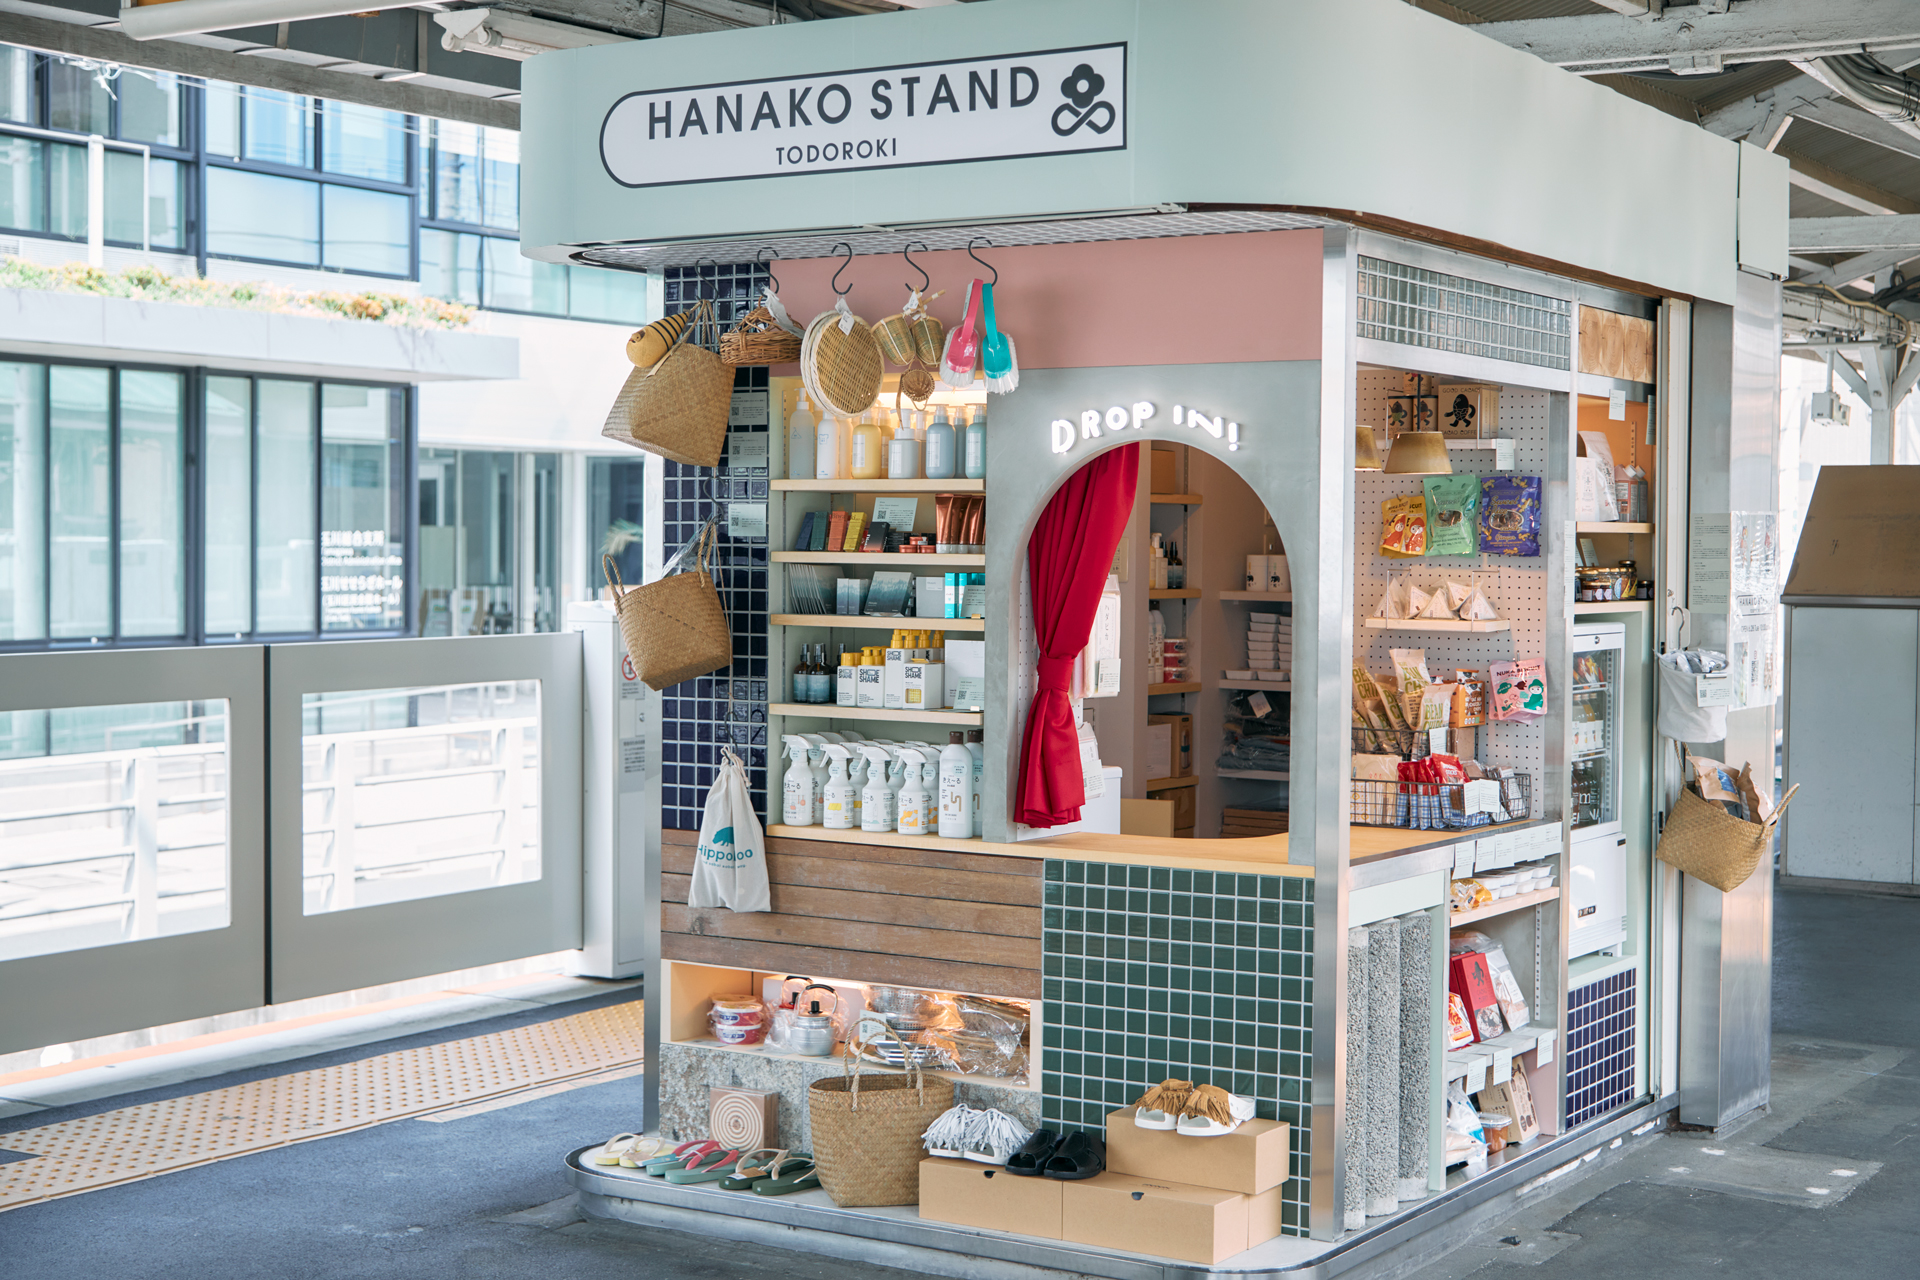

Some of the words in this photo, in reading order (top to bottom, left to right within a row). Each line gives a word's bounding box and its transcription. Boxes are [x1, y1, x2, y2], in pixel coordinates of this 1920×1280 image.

[648, 83, 852, 140] HANAKO
[870, 66, 1040, 120] STAND
[776, 137, 897, 166] TODOROKI
[1051, 401, 1156, 454] DROP
[1173, 404, 1240, 451] IN!
[1424, 703, 1444, 720] BEAN
